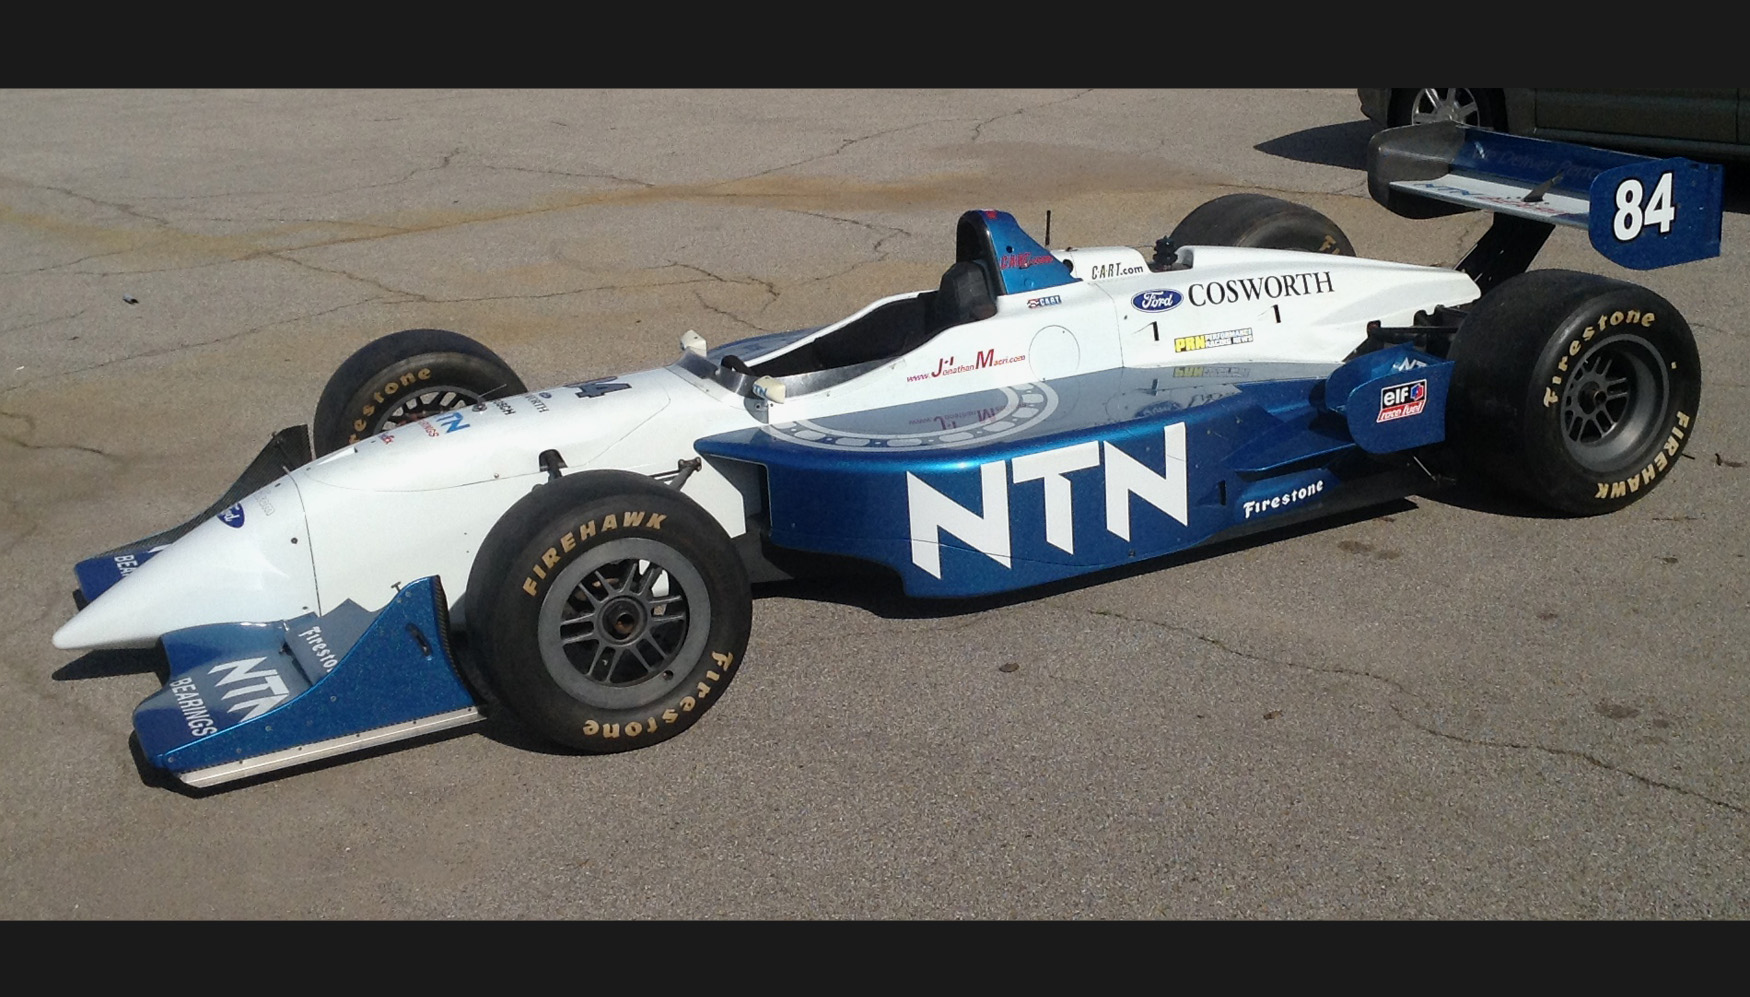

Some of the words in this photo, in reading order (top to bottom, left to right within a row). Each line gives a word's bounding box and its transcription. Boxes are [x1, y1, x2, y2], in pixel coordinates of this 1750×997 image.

[1612, 171, 1677, 242] 84
[1187, 271, 1335, 308] COSWORTH
[1175, 335, 1205, 352] PRN
[1544, 308, 1656, 408] Firestone
[350, 367, 432, 443] restone
[1383, 386, 1409, 406] elf
[1594, 410, 1690, 499] FIREHAWK
[905, 421, 1189, 580] NTN
[1242, 478, 1325, 519] Firestone
[114, 554, 139, 578] BEA
[522, 511, 668, 597] FIREHAWK
[298, 626, 339, 673] Firesto
[169, 677, 218, 738] BEARINGS
[582, 651, 734, 739] Firestone
